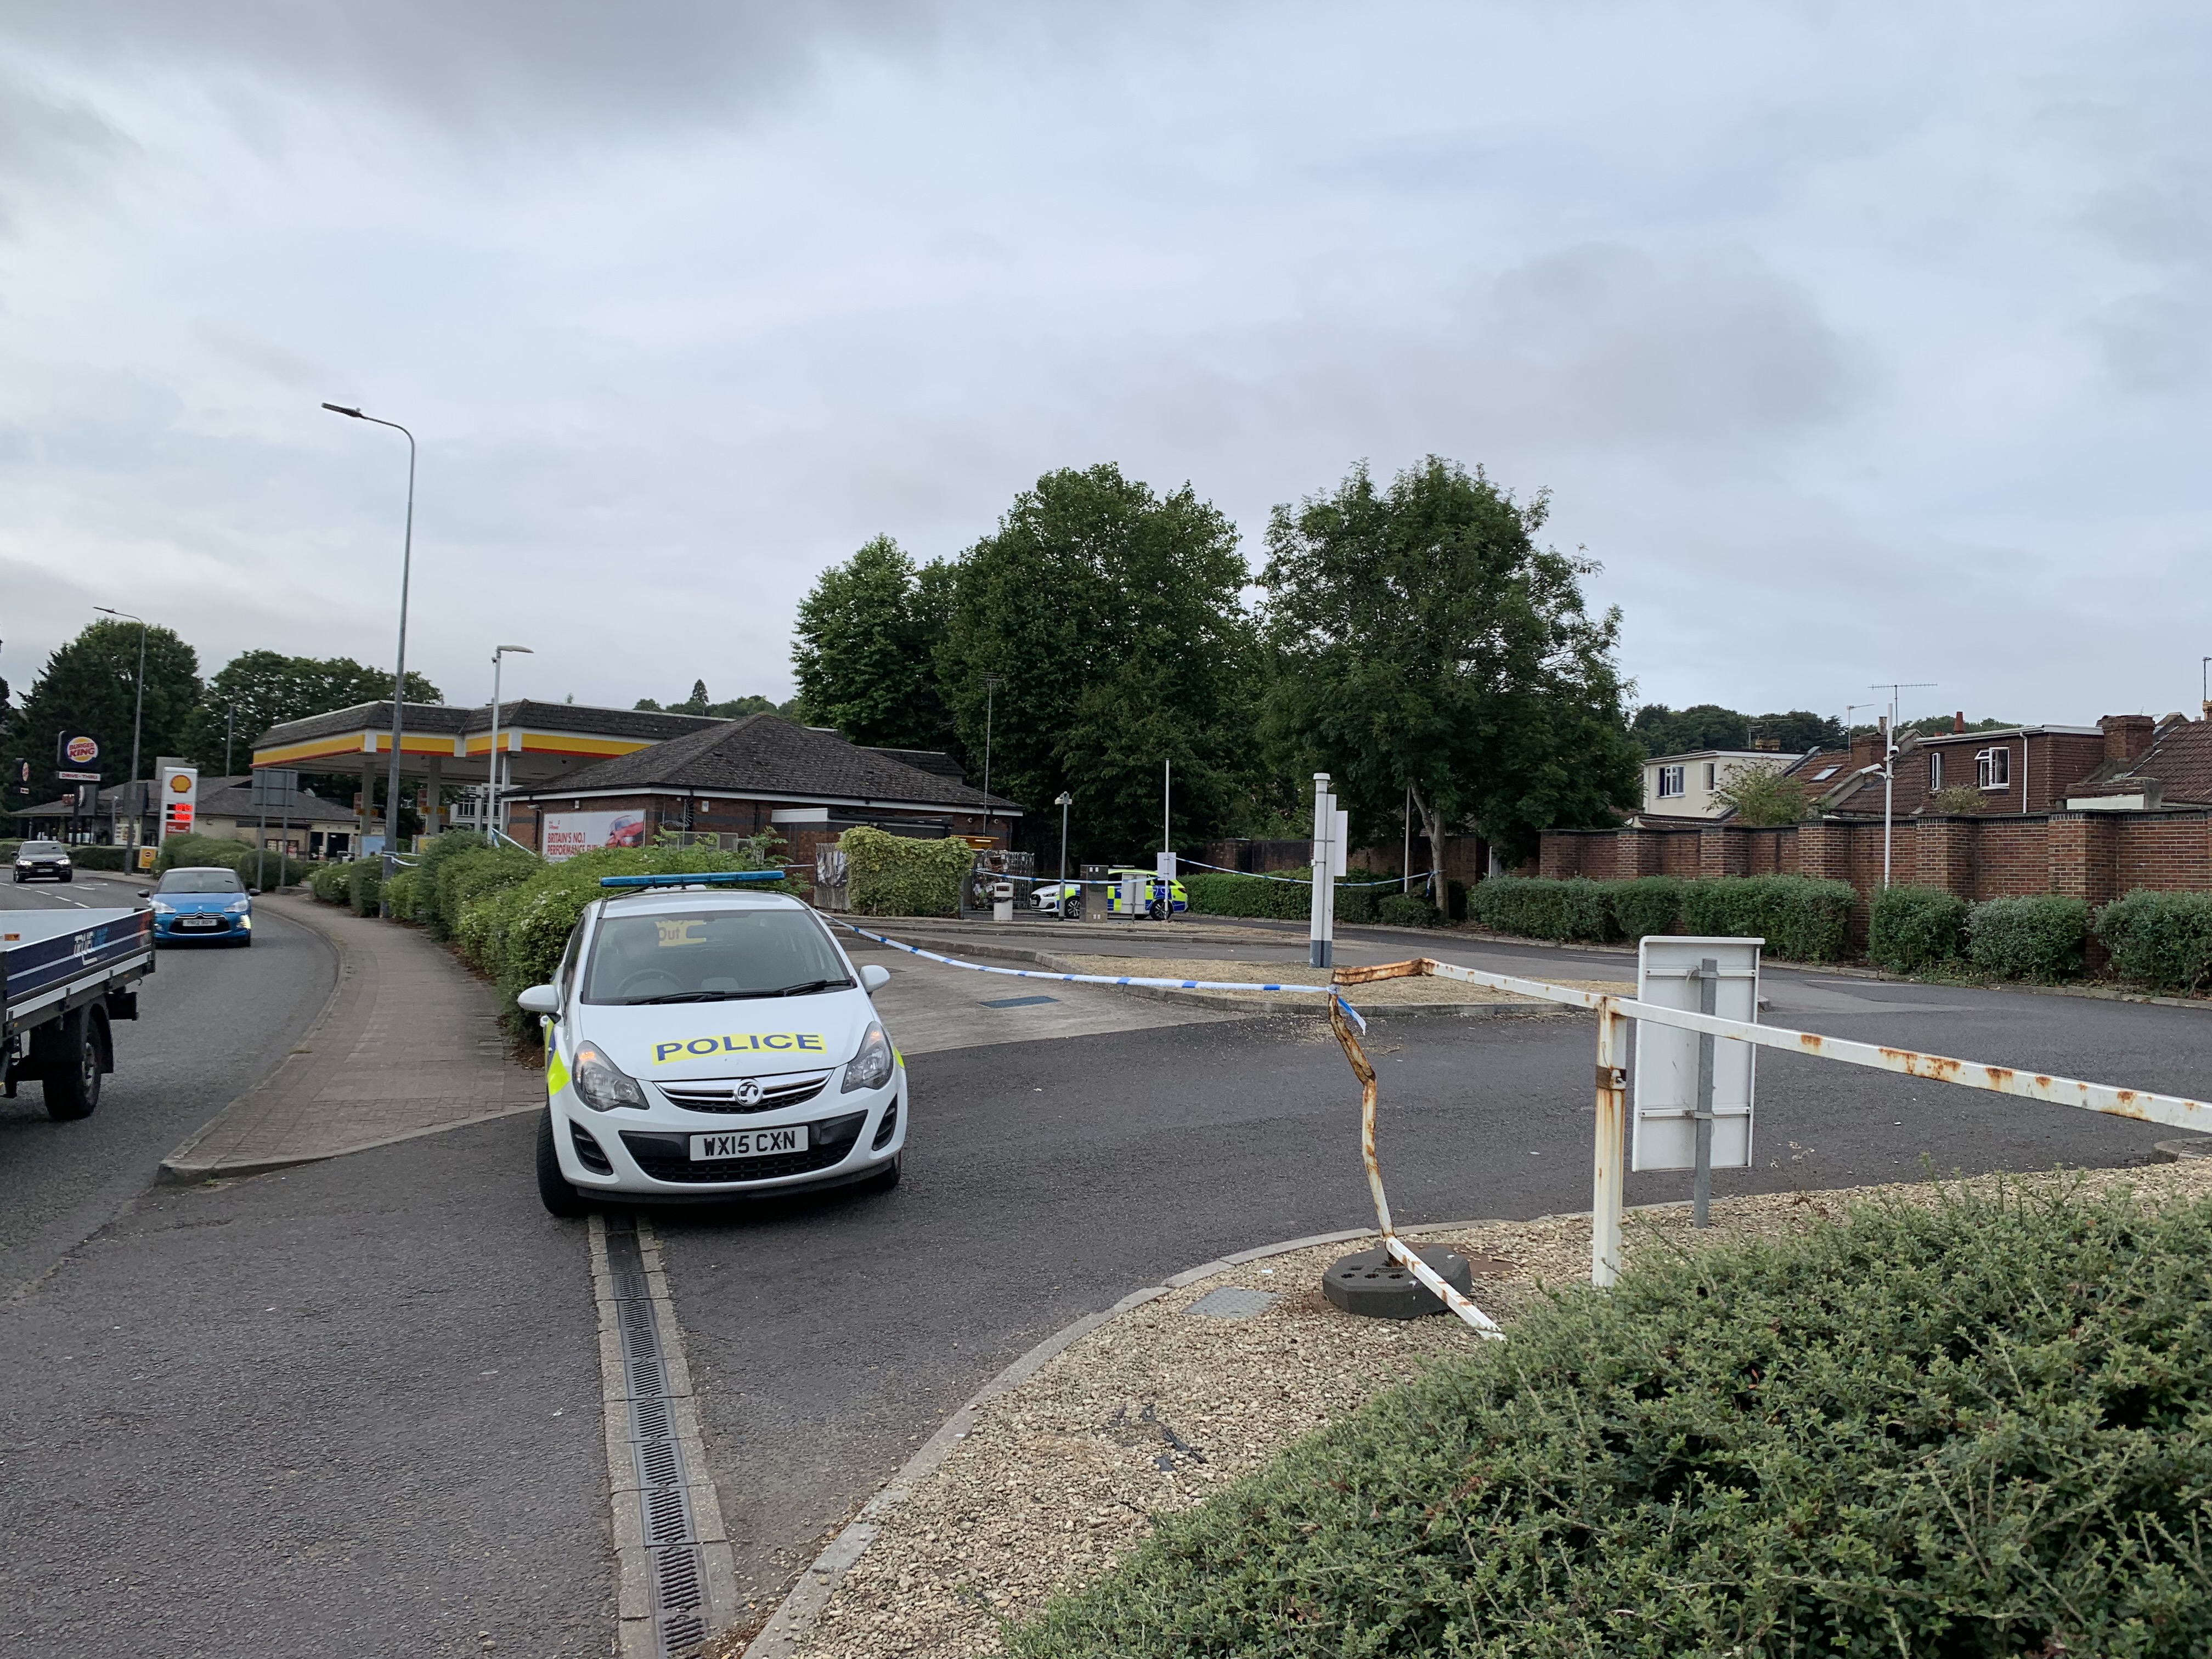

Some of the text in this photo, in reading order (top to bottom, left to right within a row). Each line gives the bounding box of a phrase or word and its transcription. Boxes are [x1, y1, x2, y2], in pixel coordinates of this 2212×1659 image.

[69, 748, 95, 757] KING
[548, 832, 585, 843] BRITAIN'S NO.1
[657, 1034, 823, 1061] POLICE
[704, 1131, 795, 1156] WX15 CXN
